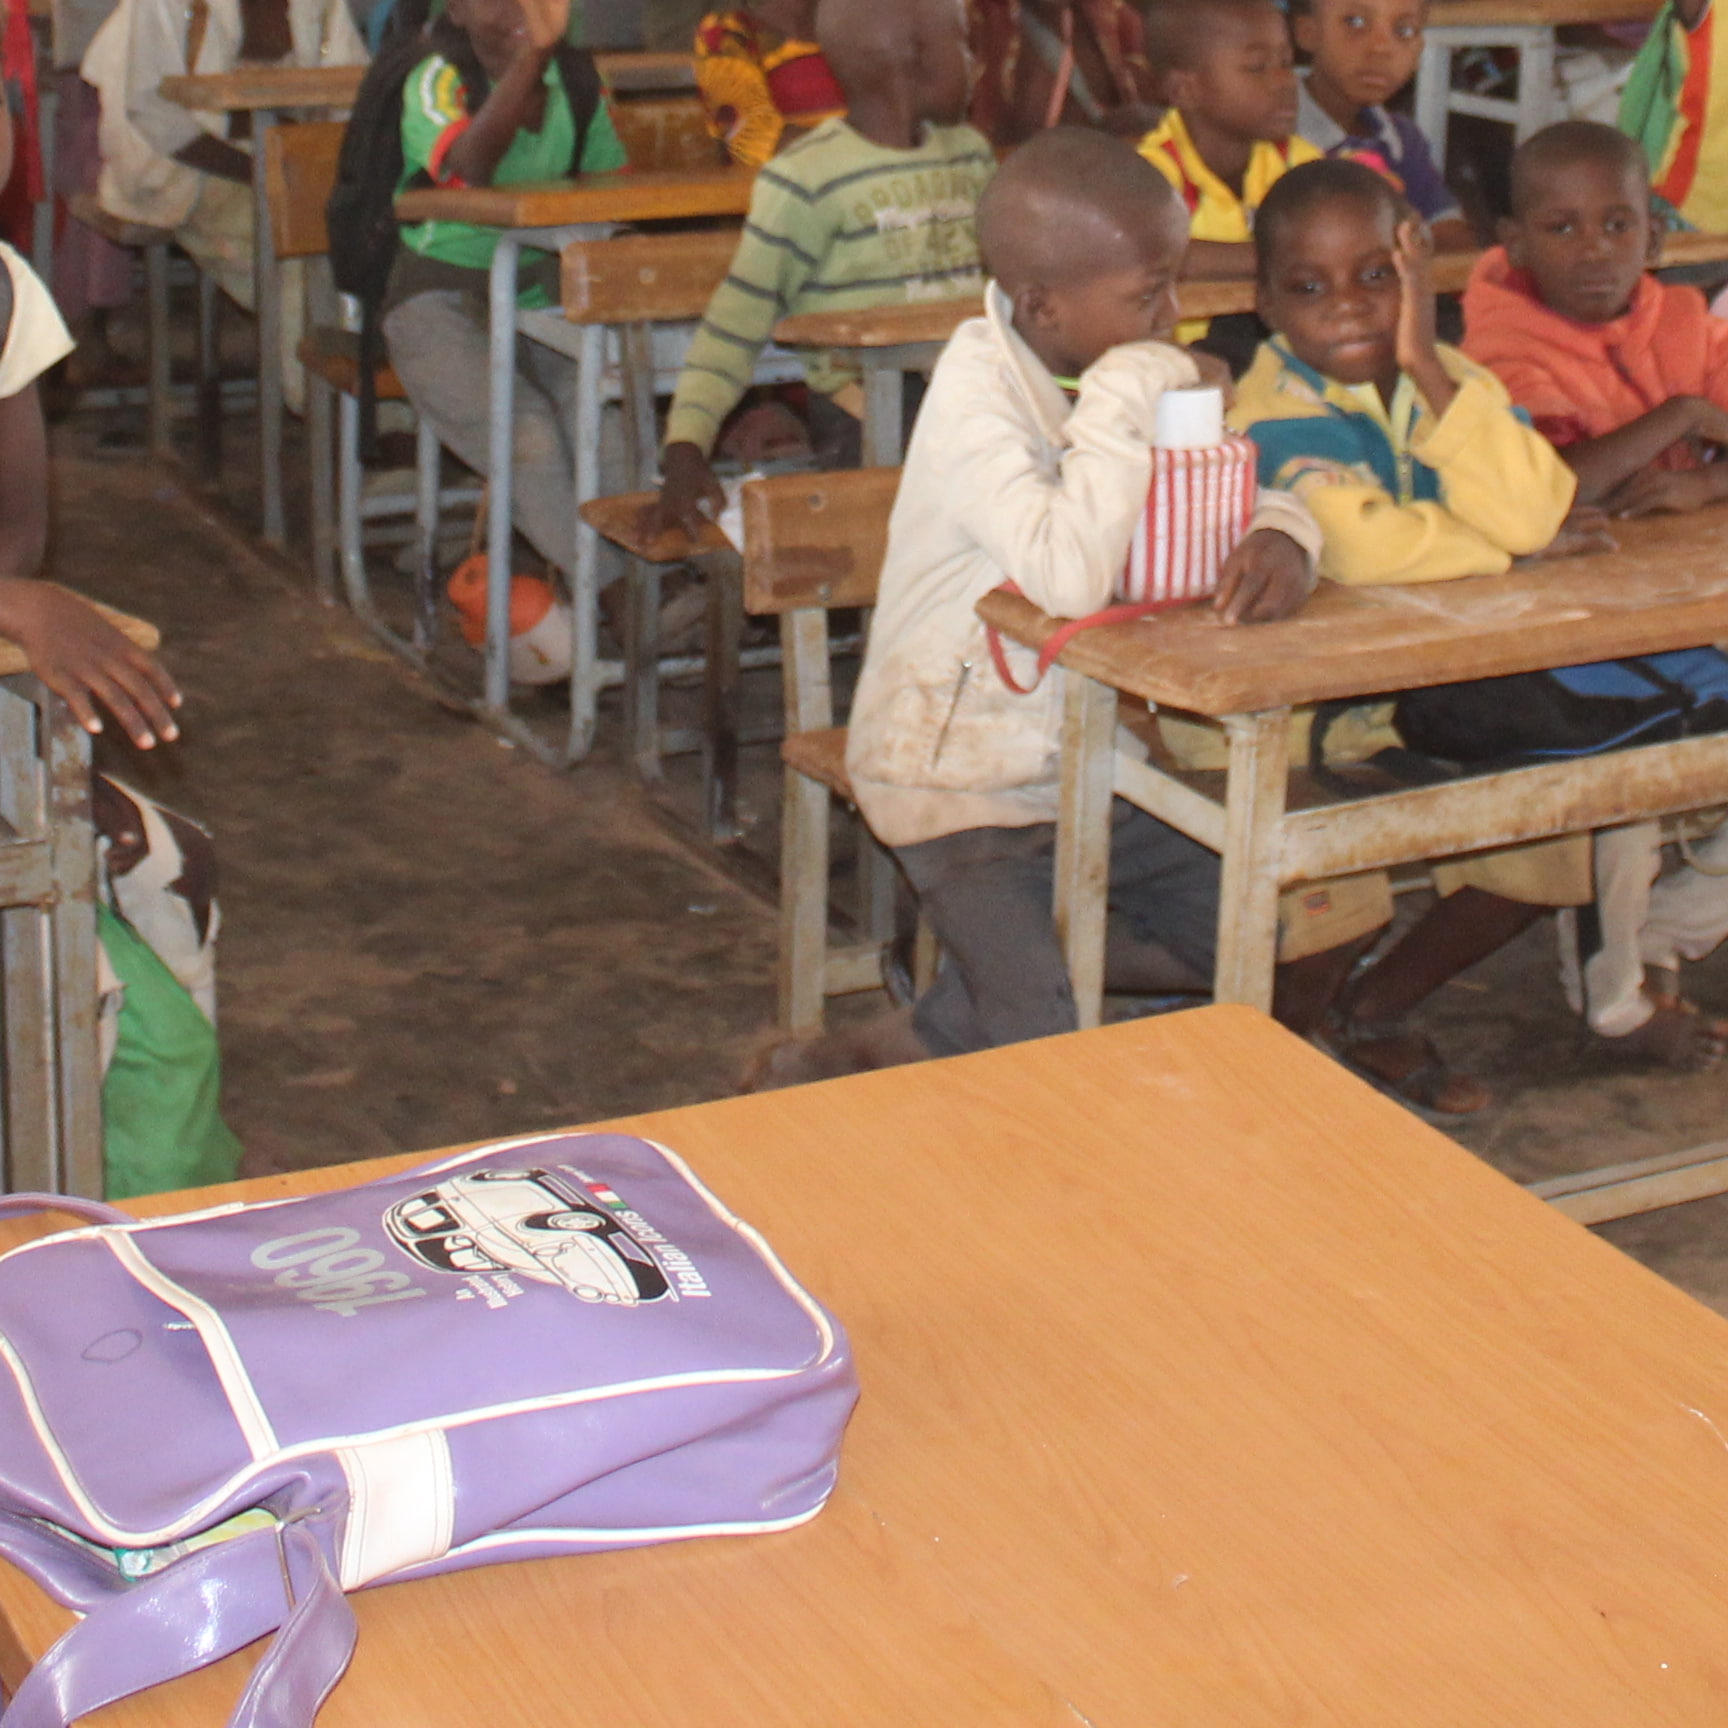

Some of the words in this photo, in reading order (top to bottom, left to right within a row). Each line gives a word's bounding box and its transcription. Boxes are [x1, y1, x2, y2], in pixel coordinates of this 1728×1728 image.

[615, 1210, 667, 1243] Icons
[250, 1224, 426, 1318] 1960
[654, 1243, 712, 1298] Italian
